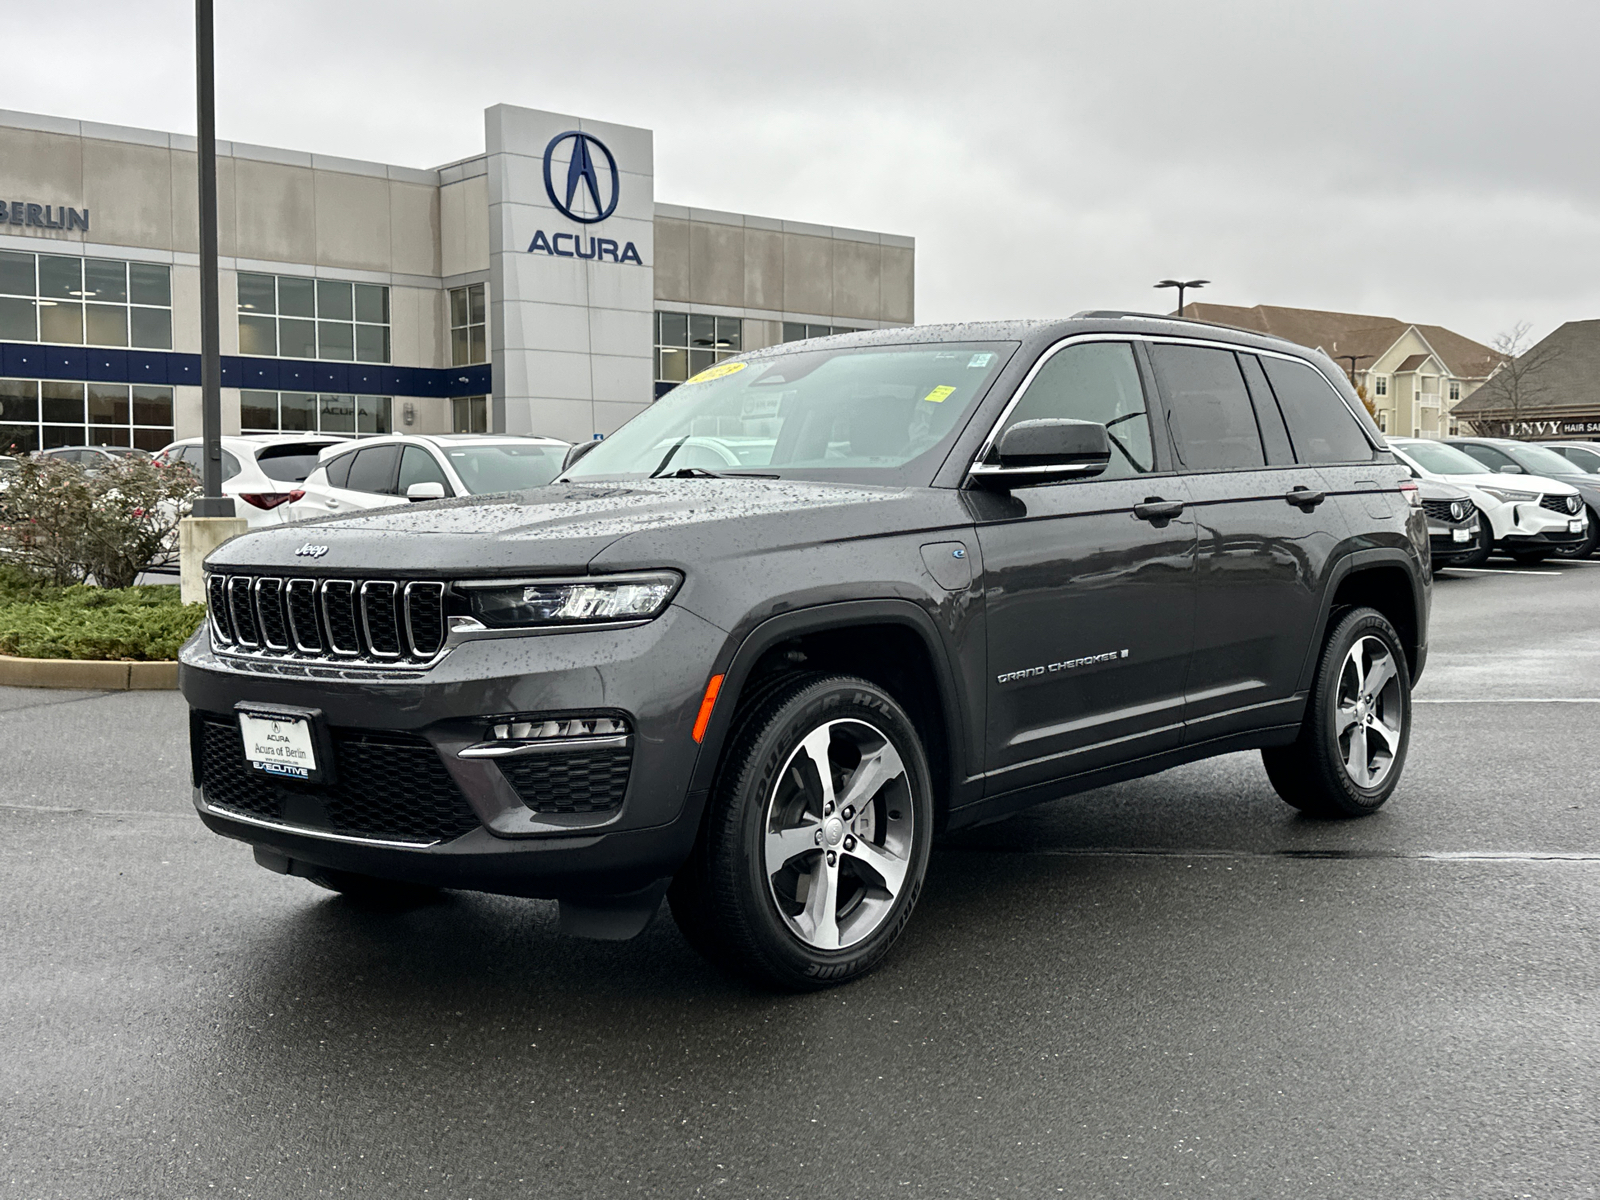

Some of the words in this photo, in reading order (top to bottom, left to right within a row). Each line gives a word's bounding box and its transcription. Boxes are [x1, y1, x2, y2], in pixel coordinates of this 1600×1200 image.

[527, 229, 643, 265] ACURA
[1509, 421, 1562, 435] ENVY
[1564, 424, 1585, 432] HAIR
[294, 542, 330, 559] Jeep
[997, 666, 1045, 683] GRAND
[1048, 651, 1118, 673] CHEROKEE
[852, 692, 893, 720] H/L
[267, 735, 290, 743] ACURA
[255, 743, 275, 756] Acura
[276, 747, 284, 756] of
[285, 747, 306, 759] Berlin
[253, 761, 308, 776] EXECUTIVE
[803, 880, 920, 979] BRIDGTONE
